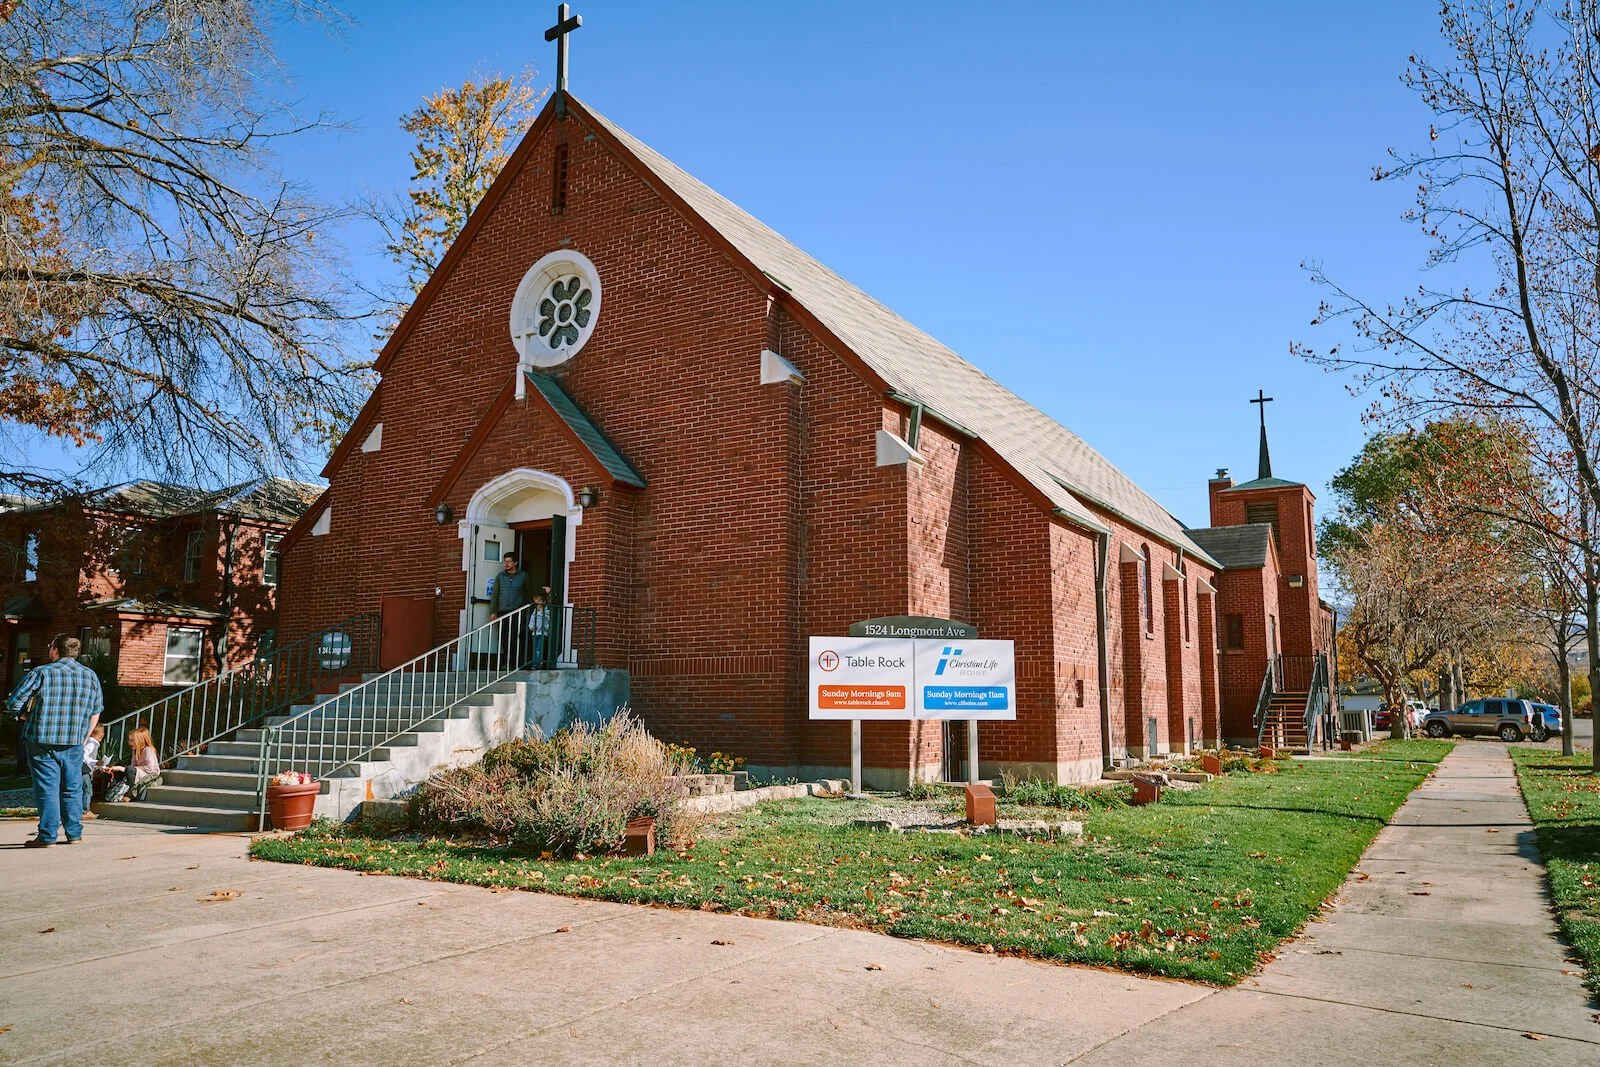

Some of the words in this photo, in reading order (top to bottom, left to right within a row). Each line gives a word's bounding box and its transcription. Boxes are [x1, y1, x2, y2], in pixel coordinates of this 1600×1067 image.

[864, 625, 887, 635] 1524
[890, 626, 944, 638] Longmont
[946, 627, 965, 636] Ave
[845, 656, 875, 667] Table
[878, 657, 905, 667] Rock
[949, 659, 983, 668] Christian
[983, 659, 998, 670] Life
[822, 690, 849, 699] Sunday
[850, 690, 884, 699] Mornings
[926, 690, 952, 699] Sunday
[954, 691, 987, 700] Mornings
